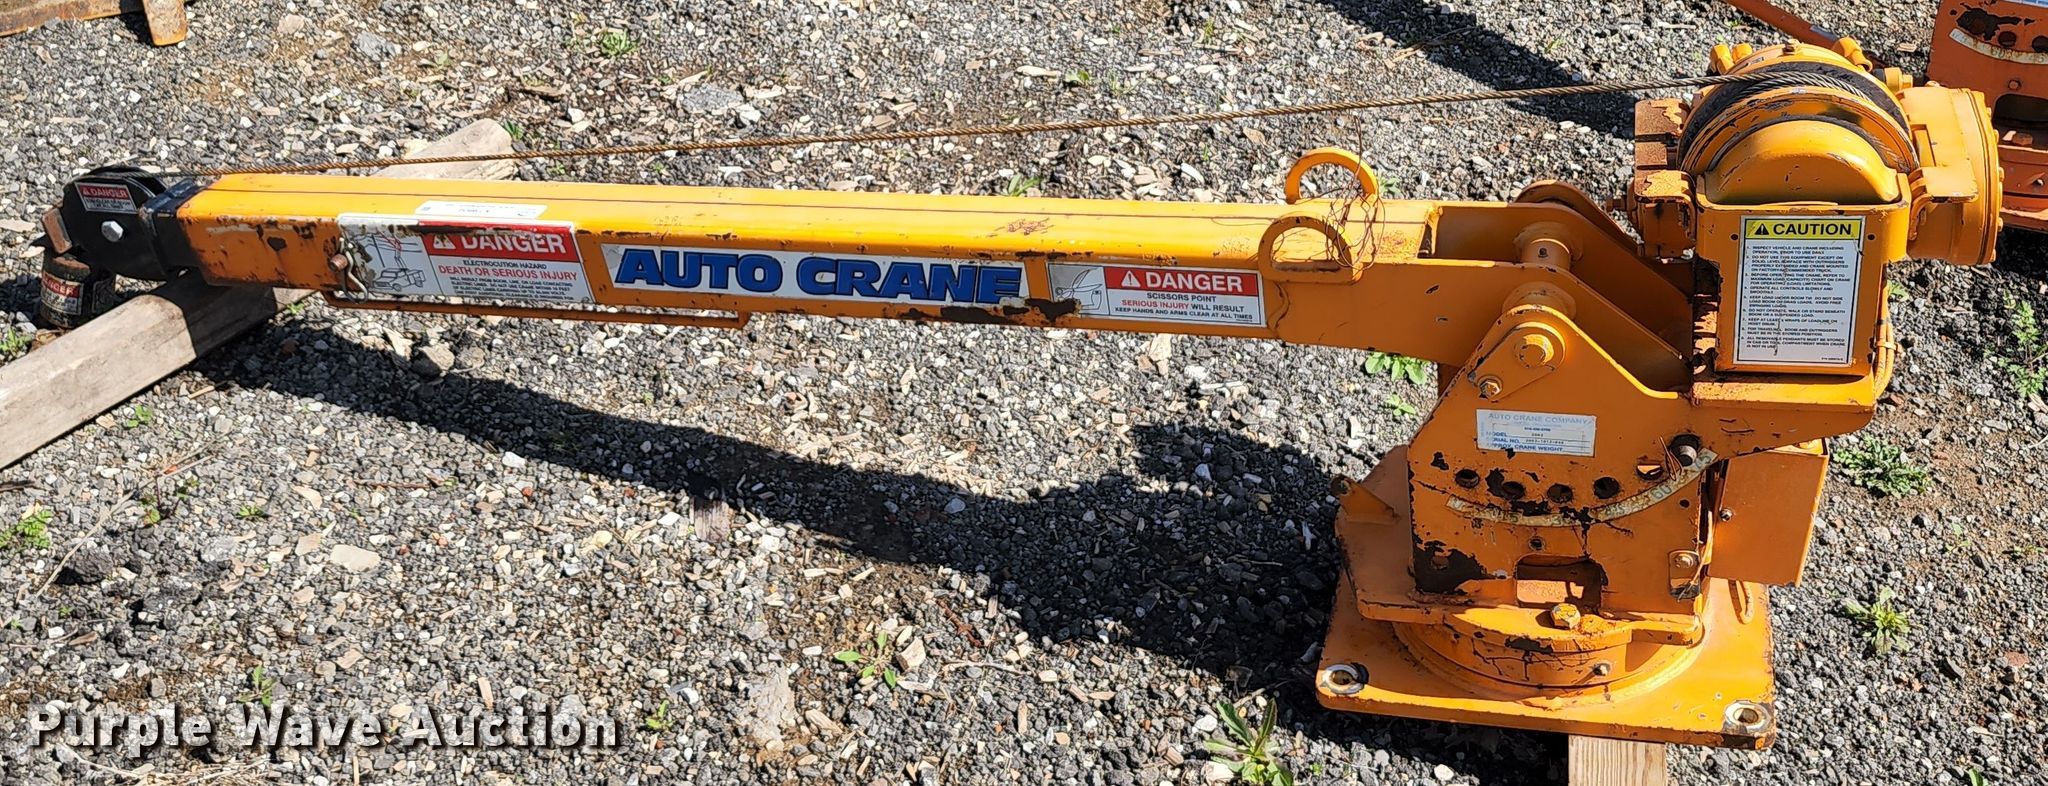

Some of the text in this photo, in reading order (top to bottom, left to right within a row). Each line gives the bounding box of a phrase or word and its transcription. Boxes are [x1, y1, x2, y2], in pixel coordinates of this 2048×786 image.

[90, 188, 127, 198] DANGER
[1773, 223, 1851, 235] CAUTION
[461, 233, 566, 253] DANGER
[438, 266, 577, 280] DEATH OR SERIOUS INJURY
[615, 248, 782, 292] AUTO
[795, 256, 1022, 305] CRANE
[1145, 272, 1242, 292] DANGER
[1147, 292, 1190, 300] SCISSORS
[1488, 413, 1511, 421] AUTO
[1545, 416, 1587, 424] COMPANY
[1650, 484, 1672, 499] 60
